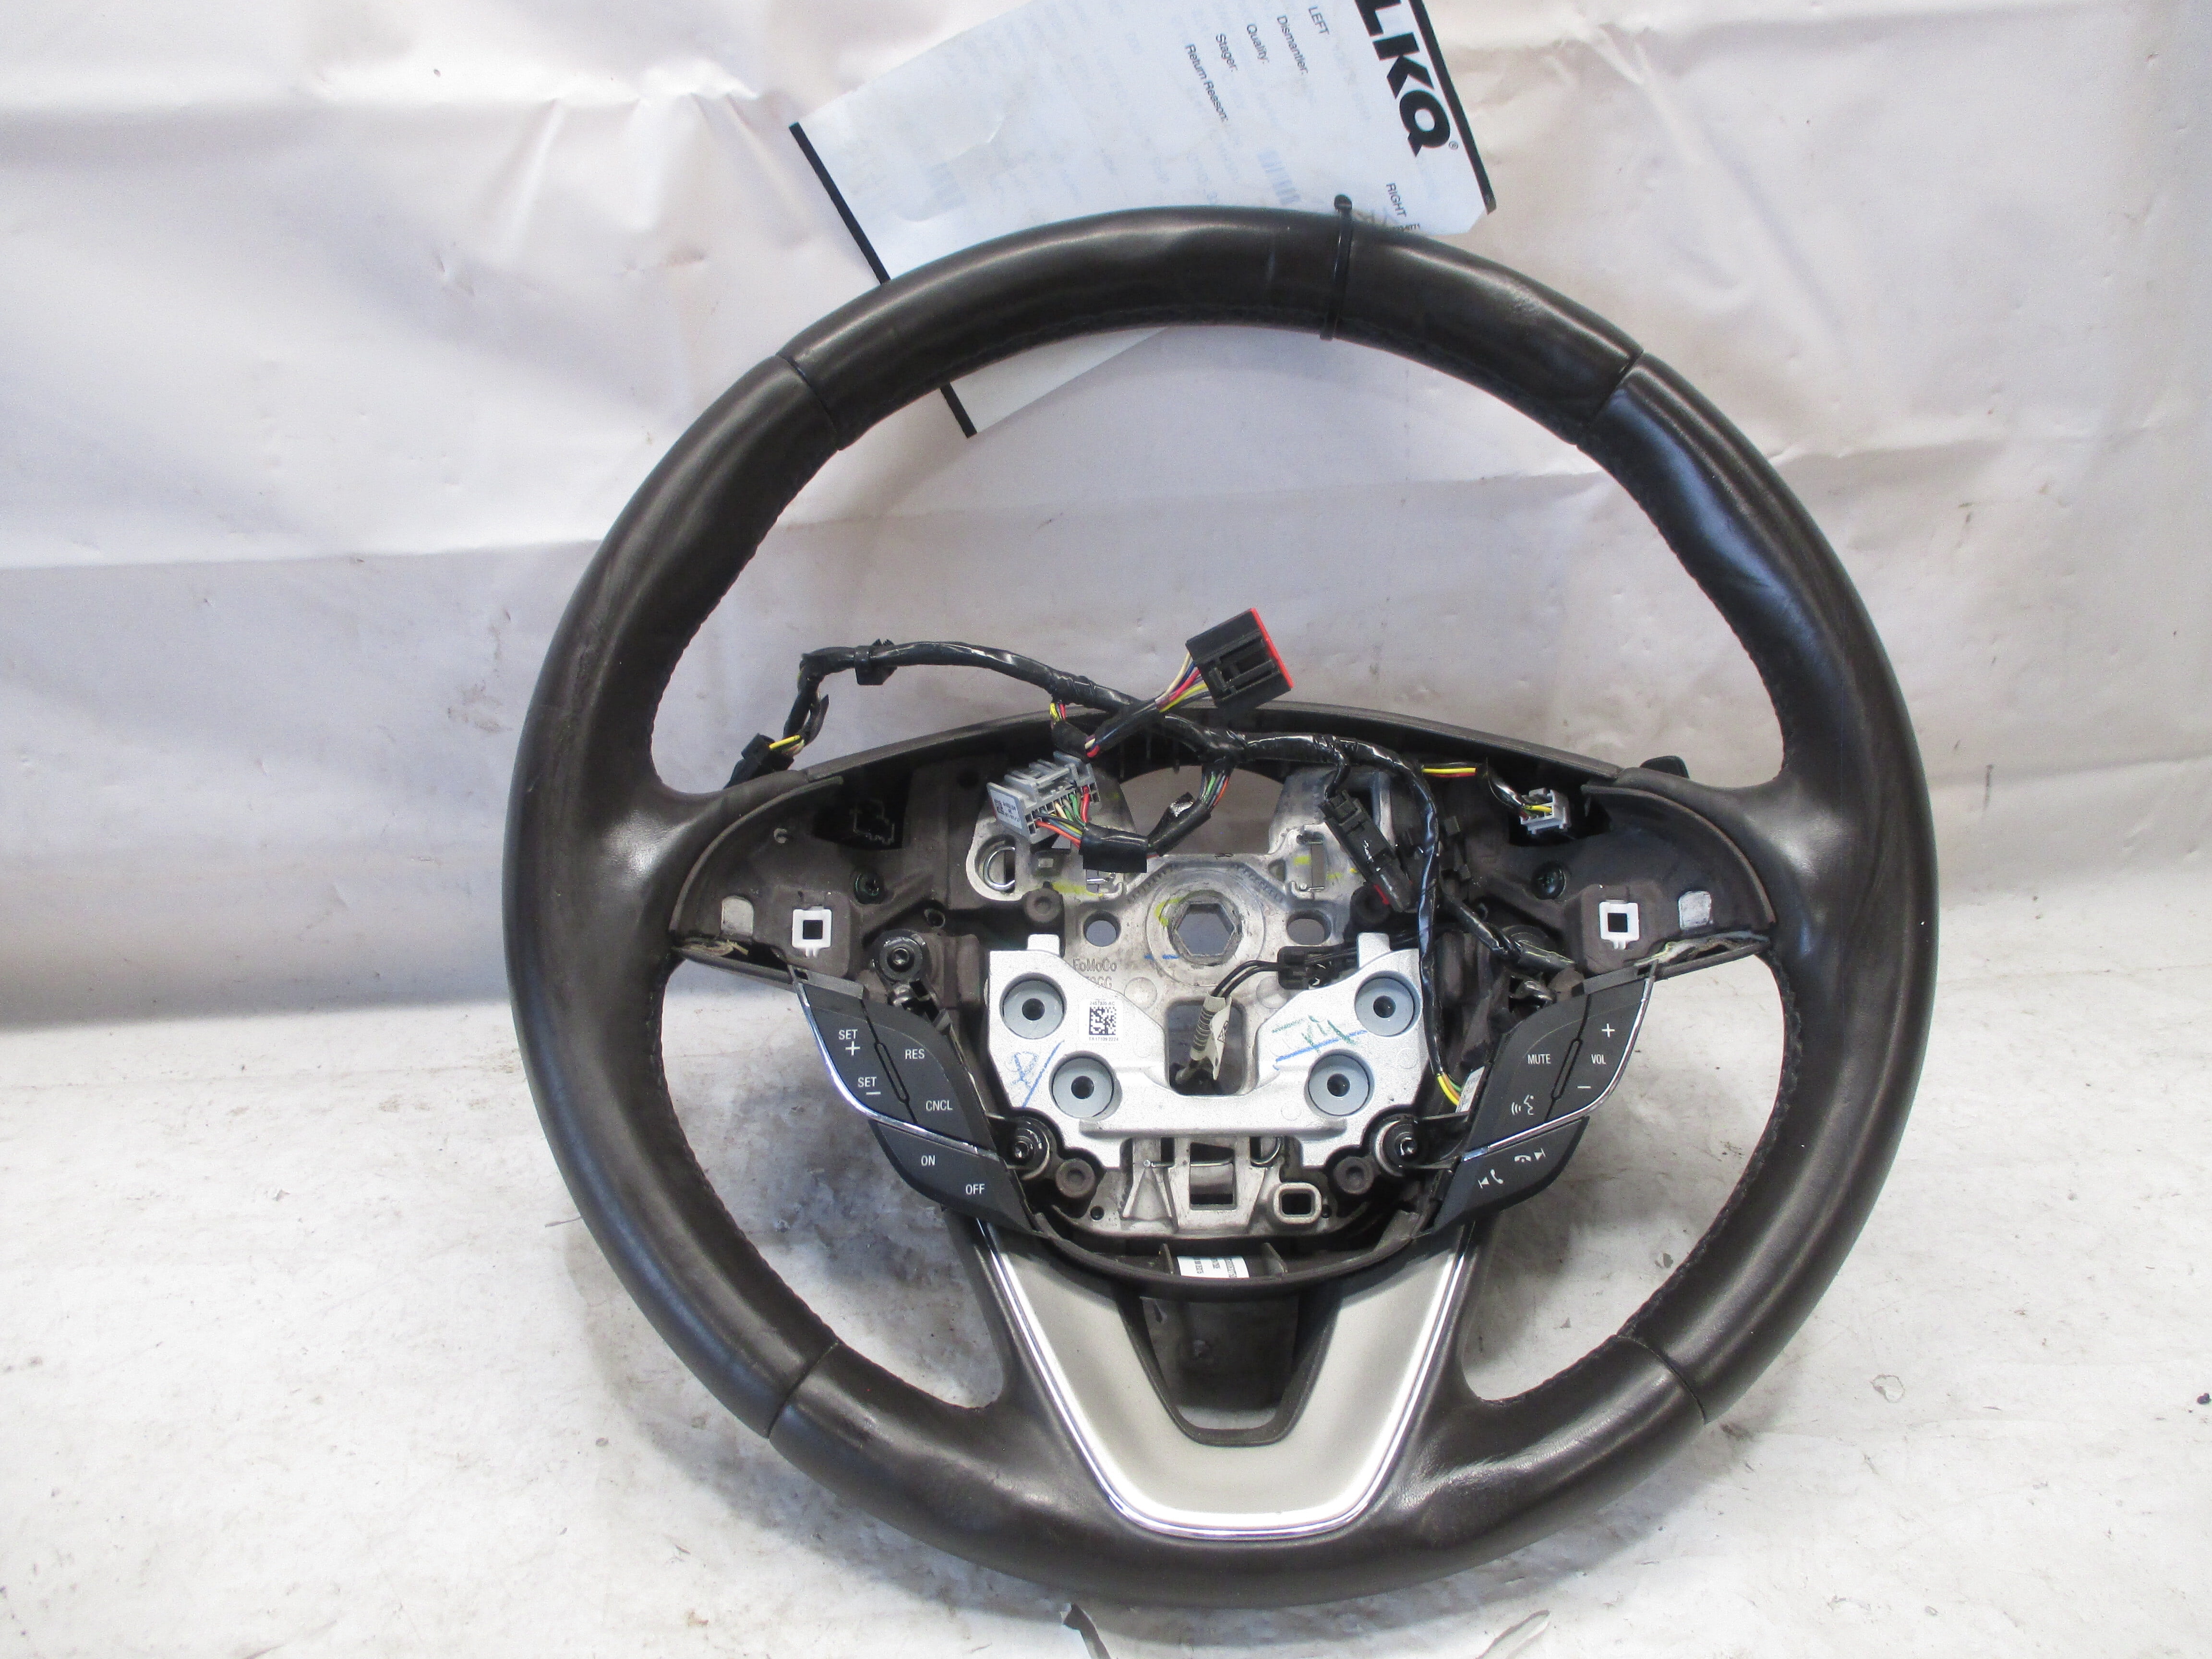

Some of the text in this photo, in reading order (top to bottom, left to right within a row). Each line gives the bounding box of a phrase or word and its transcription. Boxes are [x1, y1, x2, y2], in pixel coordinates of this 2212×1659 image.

[1308, 6, 1329, 35] LEFT
[1185, 44, 1207, 80] Return
[1355, 0, 1451, 157] LKQ
[1386, 183, 1407, 217] RIGHT
[1073, 957, 1117, 972] FoMoCo
[839, 1029, 858, 1040] SET
[905, 1049, 925, 1059] RES
[1527, 1054, 1551, 1065] MUTE
[1591, 1054, 1606, 1065] VOL
[857, 1077, 877, 1087] SET
[926, 1100, 953, 1111] CNCL
[921, 1155, 936, 1166] ON
[965, 1183, 985, 1195] OFF
